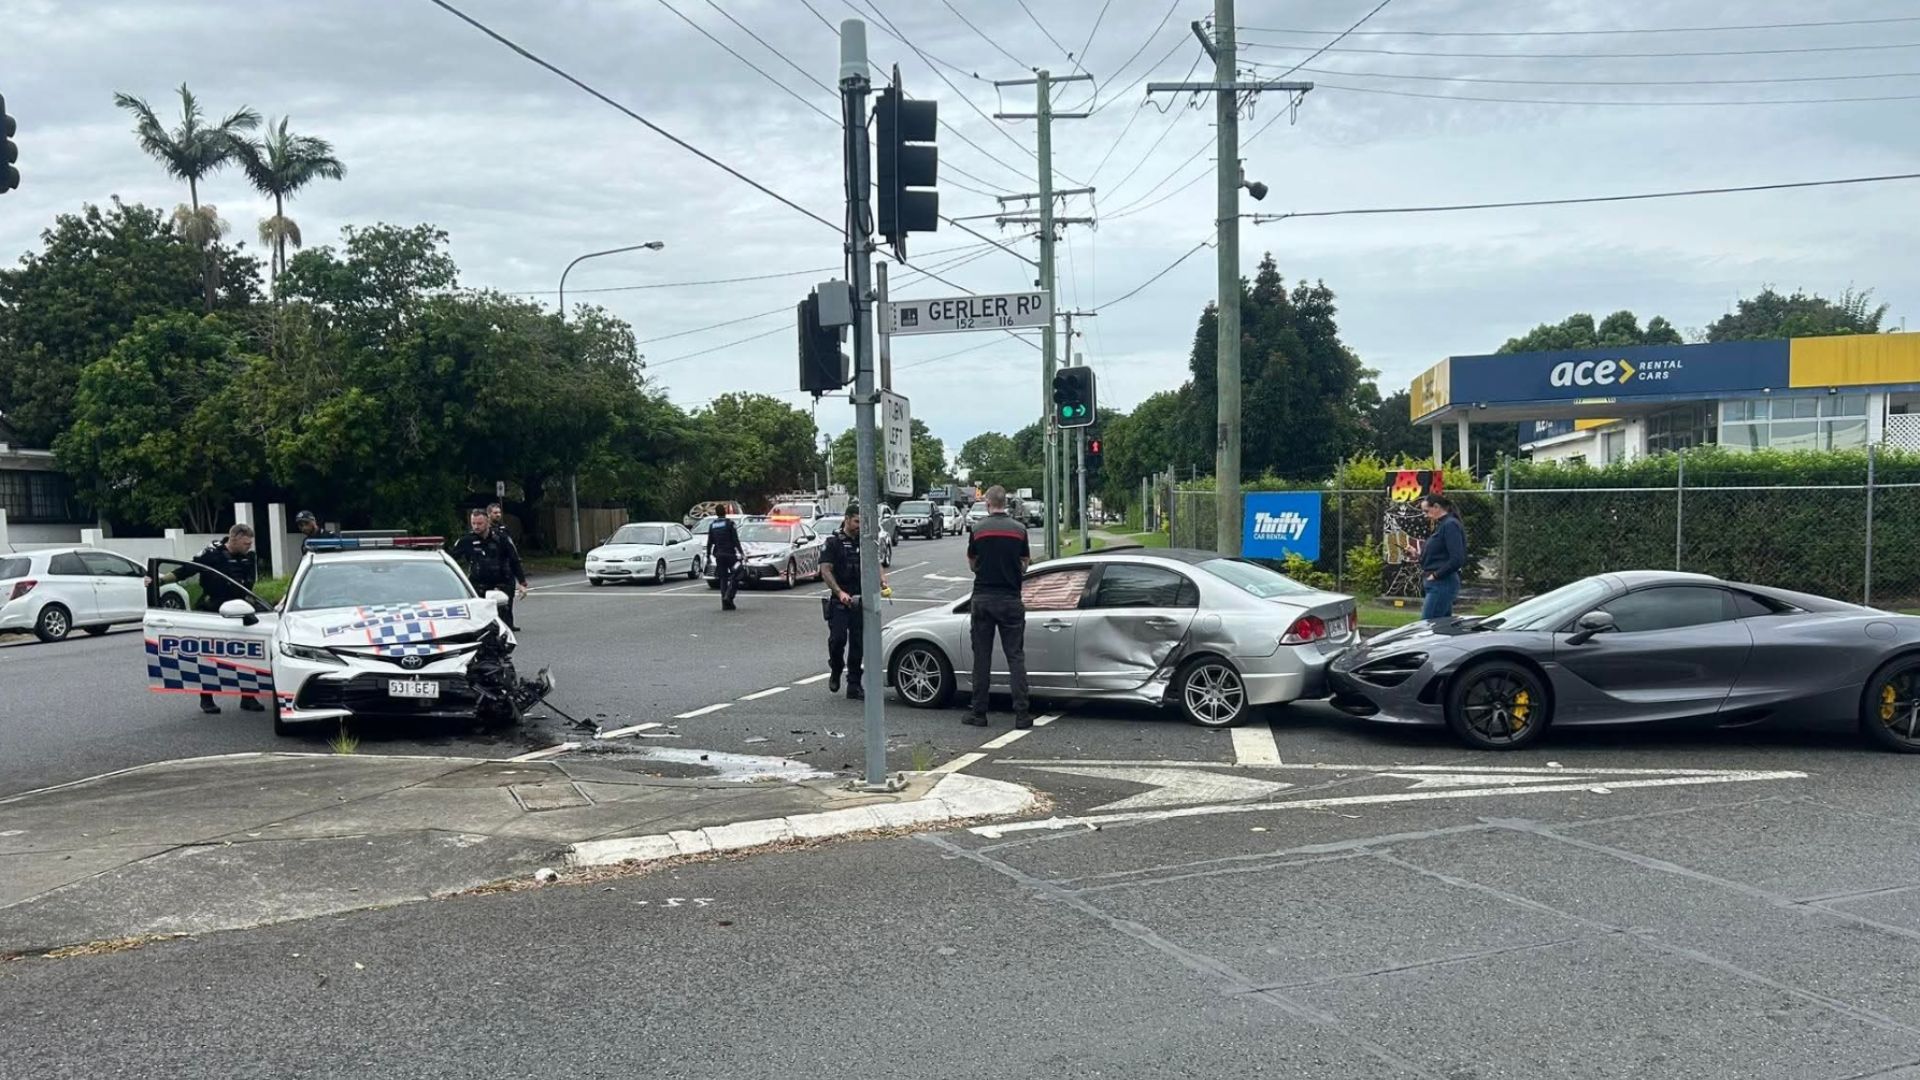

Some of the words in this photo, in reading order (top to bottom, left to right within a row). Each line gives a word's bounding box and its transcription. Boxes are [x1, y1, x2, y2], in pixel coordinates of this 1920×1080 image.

[928, 297, 1008, 321] GERLER
[1017, 295, 1042, 315] RD
[956, 319, 975, 330] 152
[999, 316, 1014, 327] 116
[1550, 359, 1617, 387] ace
[1639, 359, 1684, 371] RENTAL
[1638, 371, 1670, 381] CARS
[1253, 512, 1309, 540] Thrifty
[1266, 533, 1287, 541] RENTAL
[160, 636, 264, 658] POLICE
